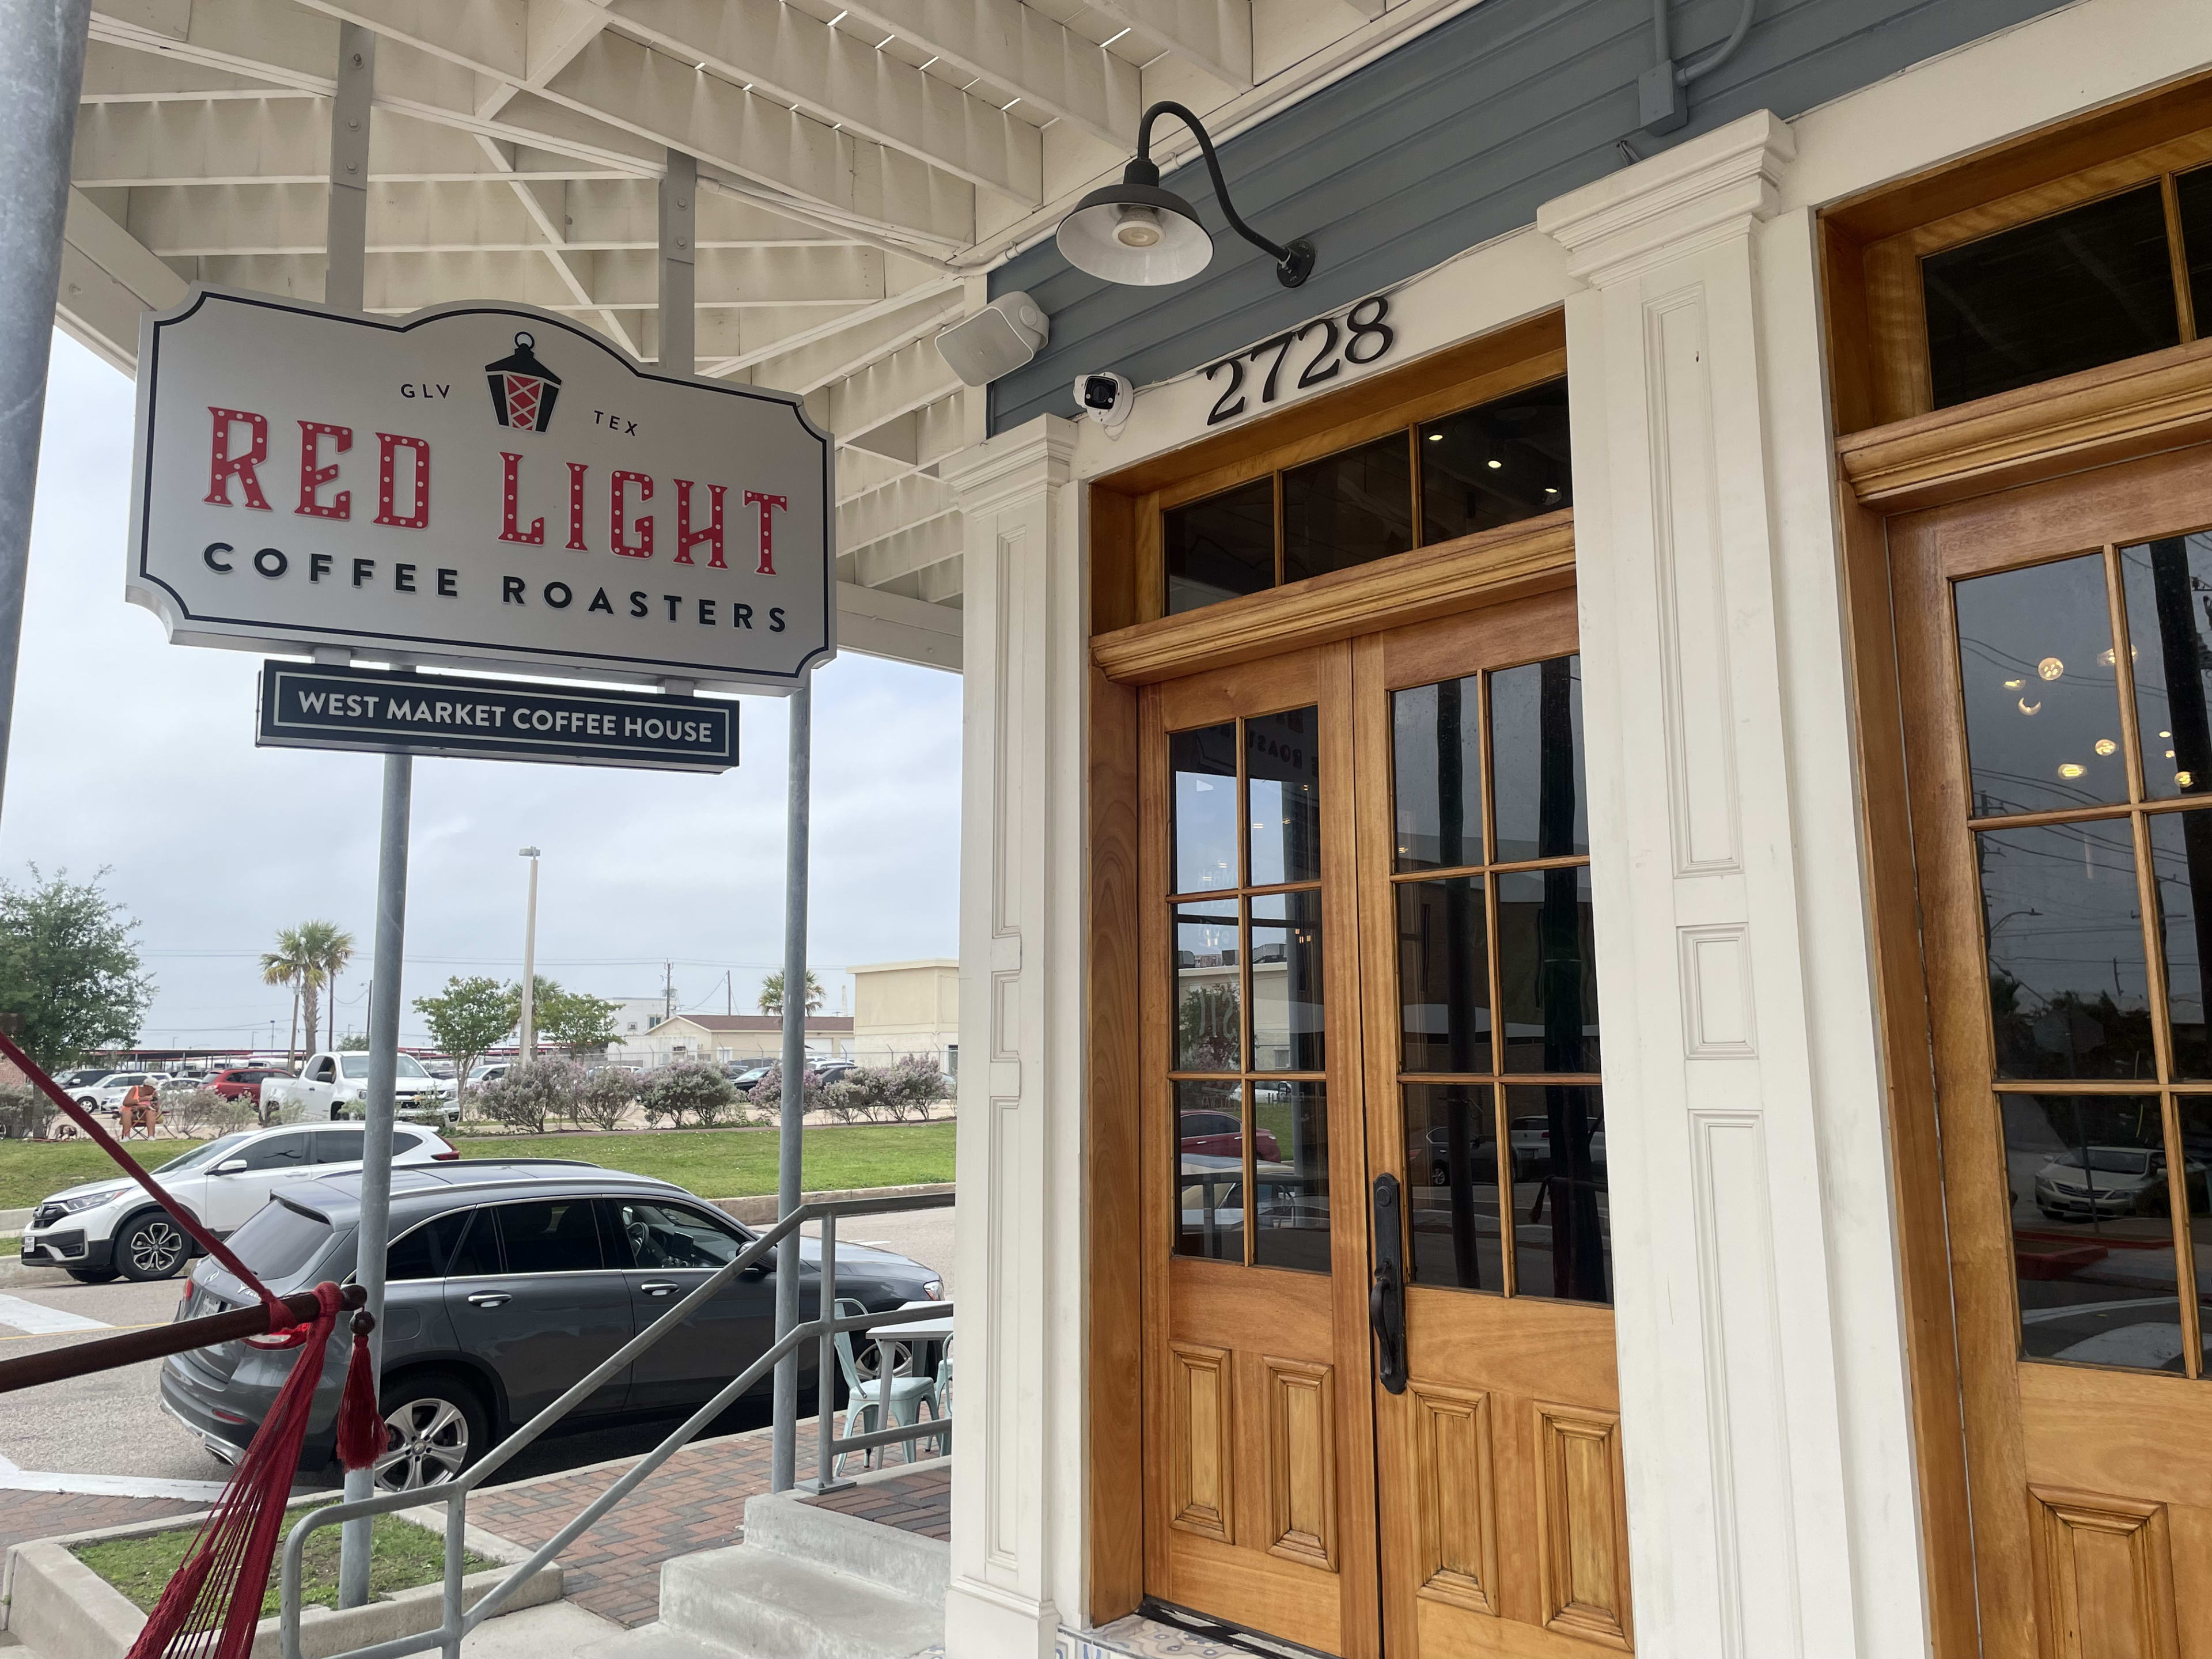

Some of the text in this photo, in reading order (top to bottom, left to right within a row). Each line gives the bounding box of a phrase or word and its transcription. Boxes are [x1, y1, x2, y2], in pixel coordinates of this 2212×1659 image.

[400, 383, 450, 399] GLV
[1206, 296, 1394, 426] 2728
[594, 410, 638, 437] TEX
[203, 406, 788, 575] RED LIGHT
[203, 542, 786, 633] COFFEE ROASTERS
[298, 691, 711, 743] WEST MARKET COFFEE HOUSE
